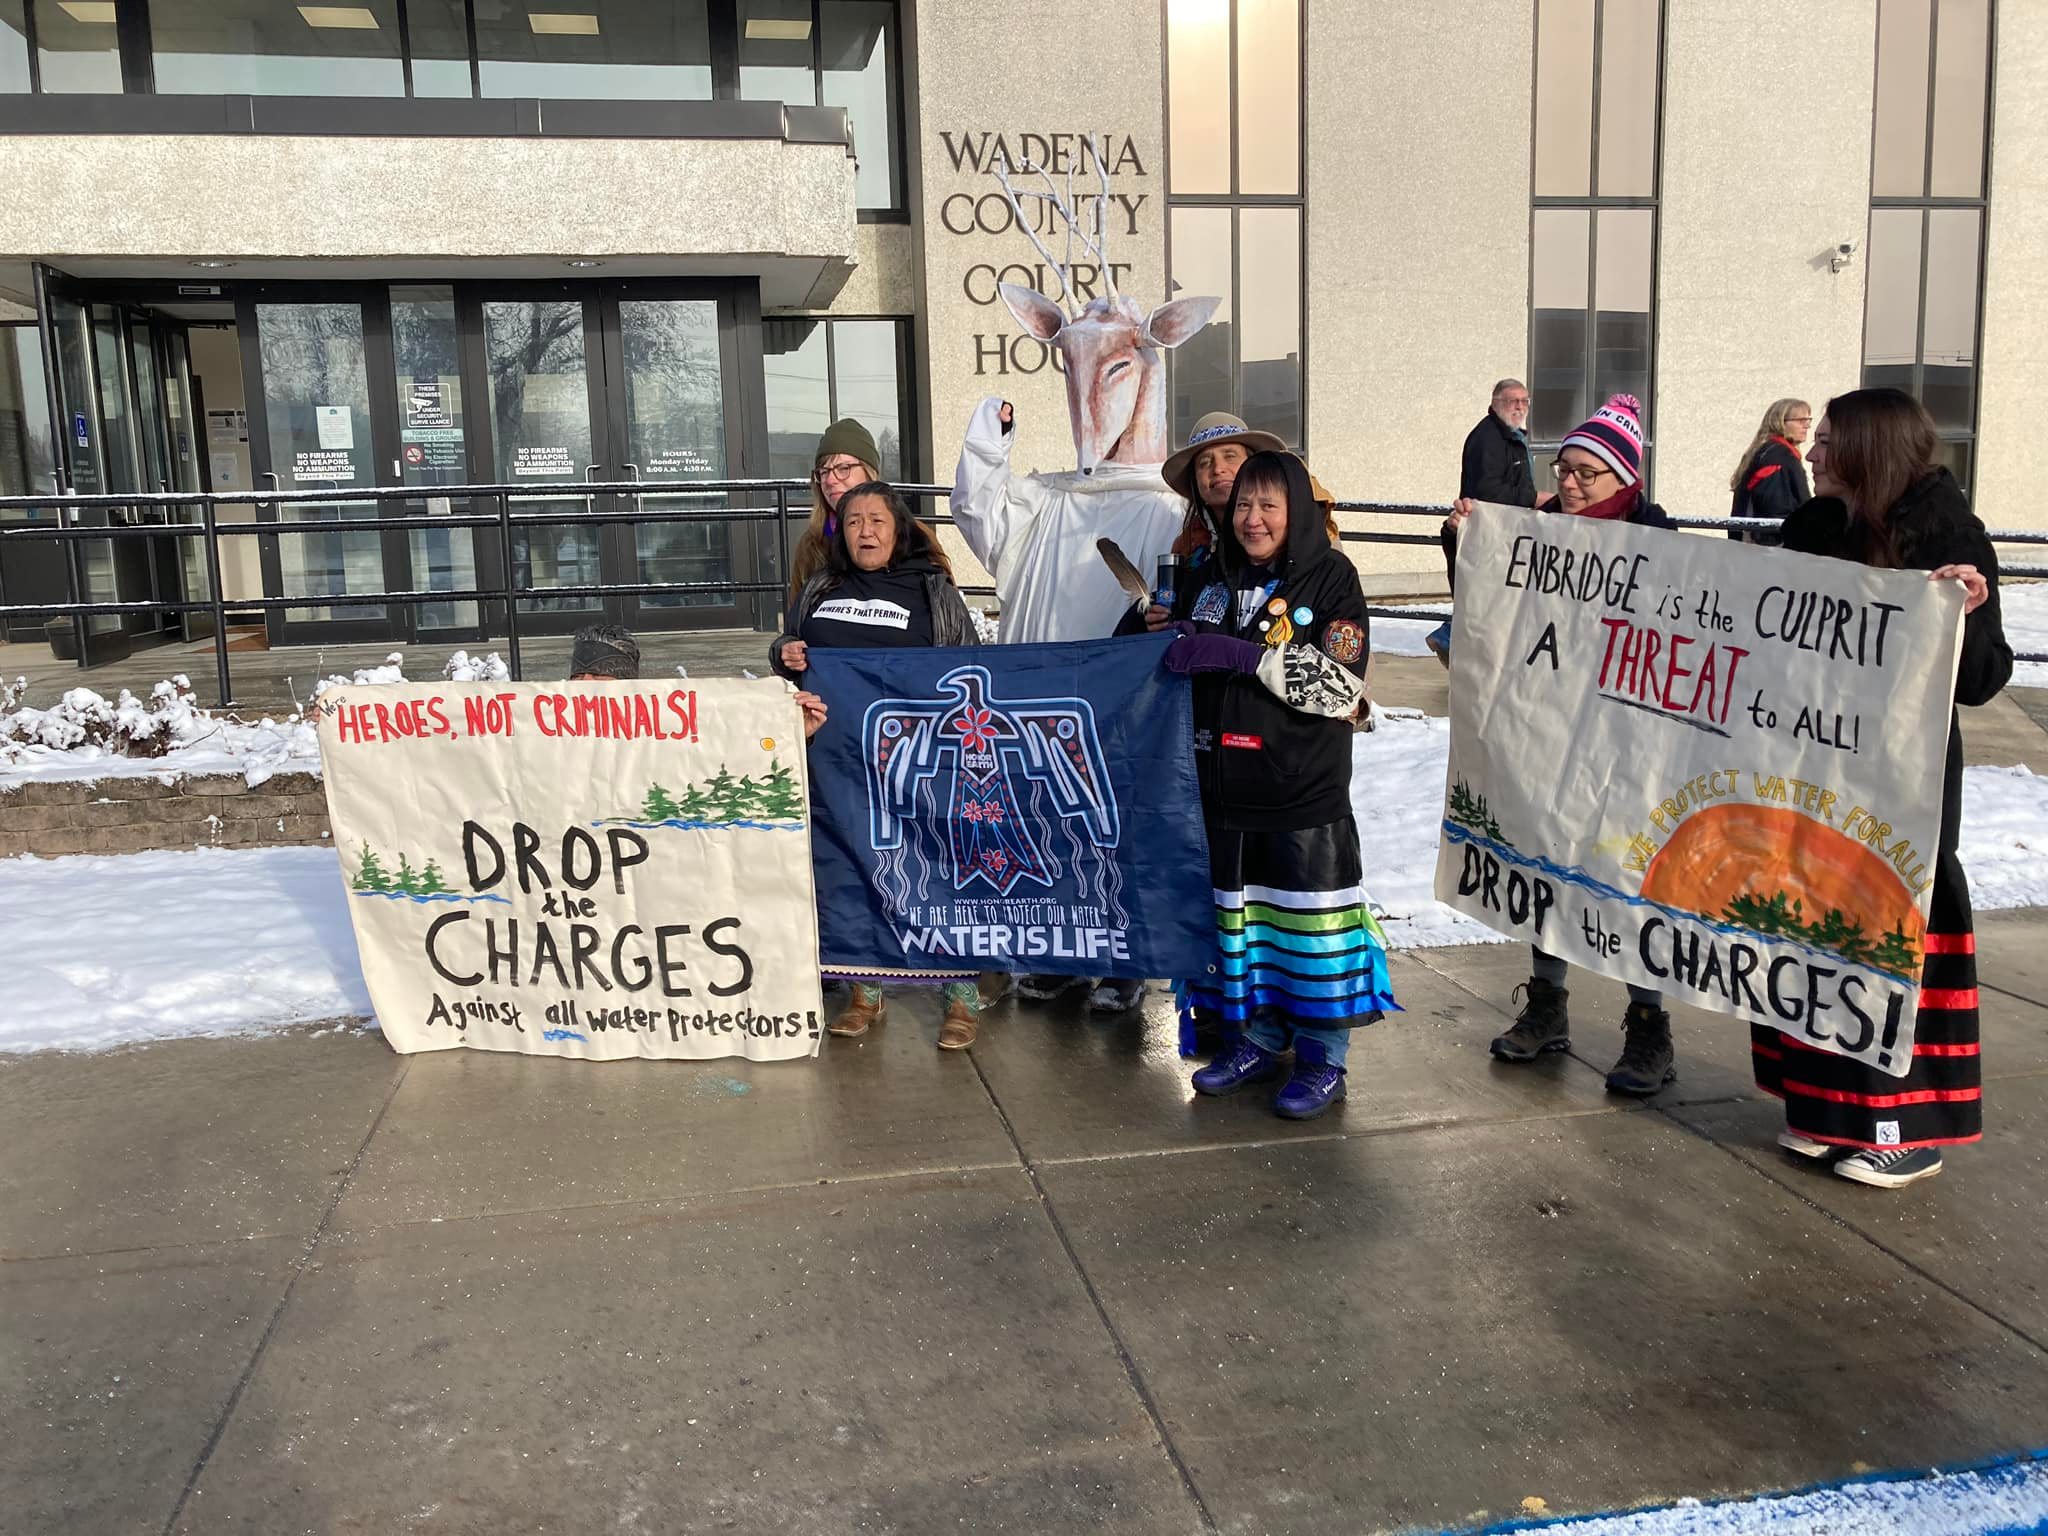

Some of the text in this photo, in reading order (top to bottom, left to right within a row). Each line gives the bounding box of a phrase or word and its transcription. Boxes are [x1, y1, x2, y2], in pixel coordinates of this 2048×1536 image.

[939, 131, 1148, 176] WADENA
[941, 193, 1149, 235] COUNTY
[819, 606, 852, 614] WHERE'S
[853, 608, 872, 617] THAT
[1505, 536, 1904, 667] ENBRIDGE is the CULPRIT
[1526, 618, 1860, 754] A THREAT to ALL!
[337, 696, 458, 744] HEROES,
[464, 693, 517, 737] NOT
[533, 689, 699, 743] CRIMINALS!
[1622, 832, 1659, 872] WE
[1649, 769, 1740, 834] PROTECT
[1753, 772, 1837, 819] WATER
[1841, 806, 1892, 853] FOR
[462, 819, 650, 895] DROP
[540, 890, 597, 919] the
[909, 906, 922, 926] WE
[929, 905, 948, 926] ARE
[955, 905, 979, 925] HERE
[984, 905, 998, 924] TO
[1047, 905, 1066, 925] OUR
[1071, 905, 1101, 927] WATER
[425, 910, 754, 997] CHARGES
[897, 924, 1012, 956] WATER
[1052, 926, 1130, 960] LIFE
[1458, 842, 1905, 1068] DROP the CHARGES!
[426, 993, 525, 1033] Against
[545, 1000, 580, 1026] all
[586, 1005, 662, 1033] water
